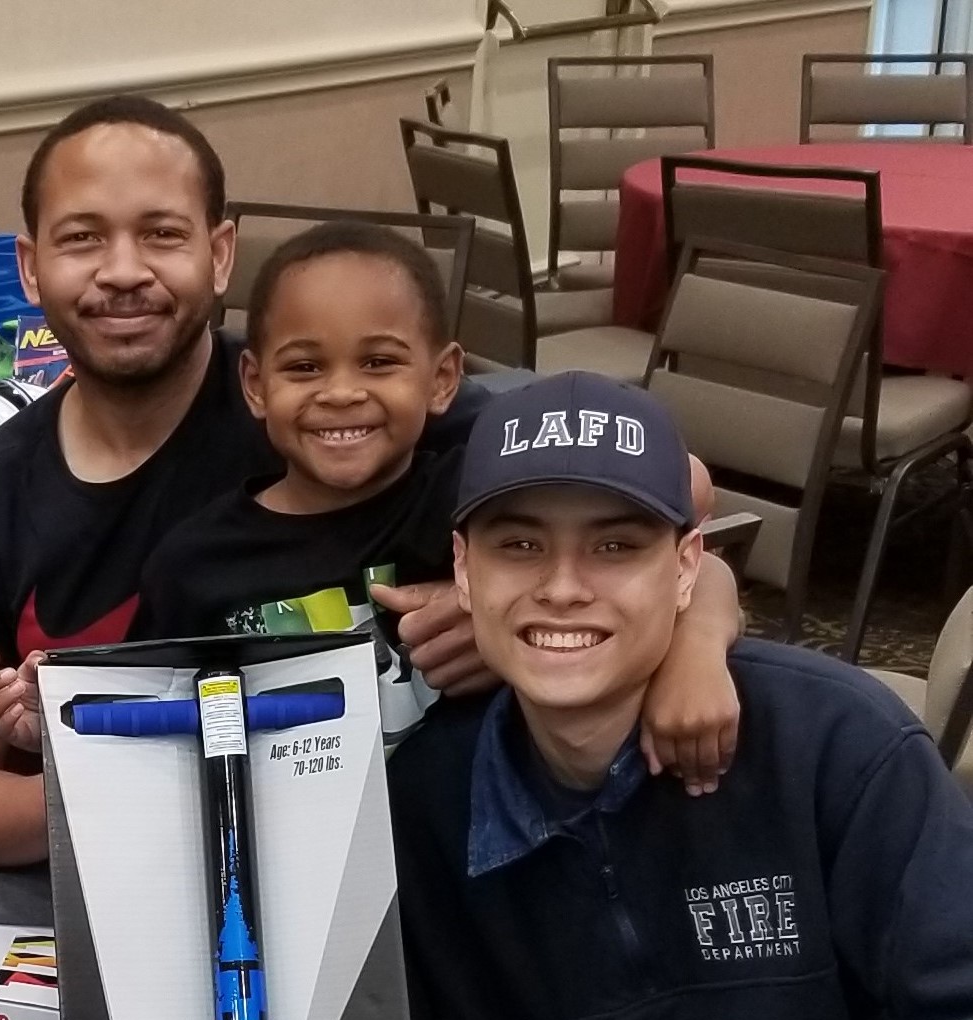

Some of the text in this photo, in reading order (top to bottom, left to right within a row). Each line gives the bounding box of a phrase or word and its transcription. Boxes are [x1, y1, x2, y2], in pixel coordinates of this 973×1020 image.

[19, 328, 59, 349] NE
[499, 409, 645, 456] LAFD
[269, 735, 342, 760] Age: 6-12 Years
[292, 755, 344, 776] 70-120 lbs.
[684, 887, 710, 901] LOS
[712, 878, 770, 899] ANGELES
[688, 892, 799, 946] FIRE
[701, 941, 801, 960] DEPARTMENT
